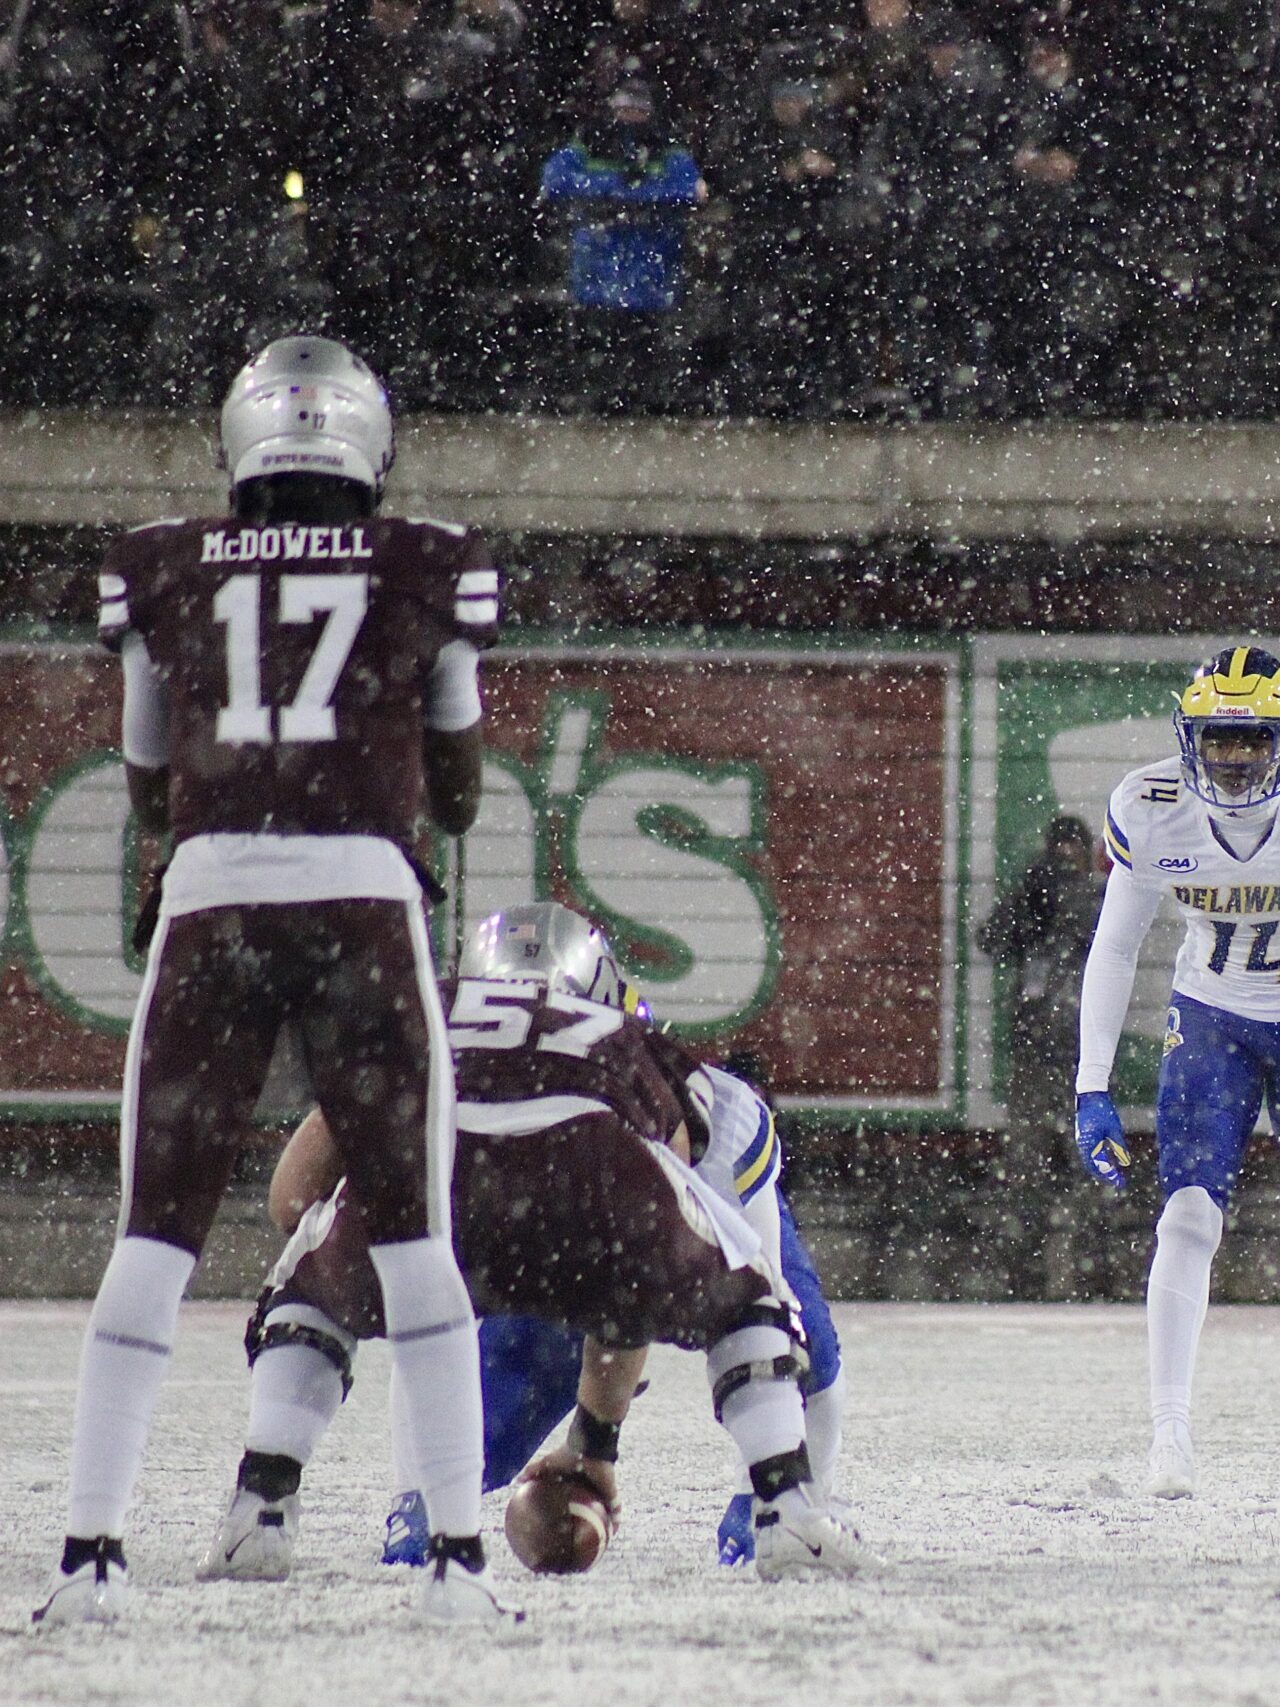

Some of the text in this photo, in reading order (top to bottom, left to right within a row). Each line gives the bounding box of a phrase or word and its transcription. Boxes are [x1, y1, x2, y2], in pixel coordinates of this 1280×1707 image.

[313, 413, 326, 429] 17
[201, 527, 373, 563] McDOWELL
[212, 574, 369, 743] 17
[1141, 778, 1179, 803] 14
[1158, 857, 1191, 868] CAA
[525, 943, 541, 958] 57
[447, 978, 625, 1059] 57
